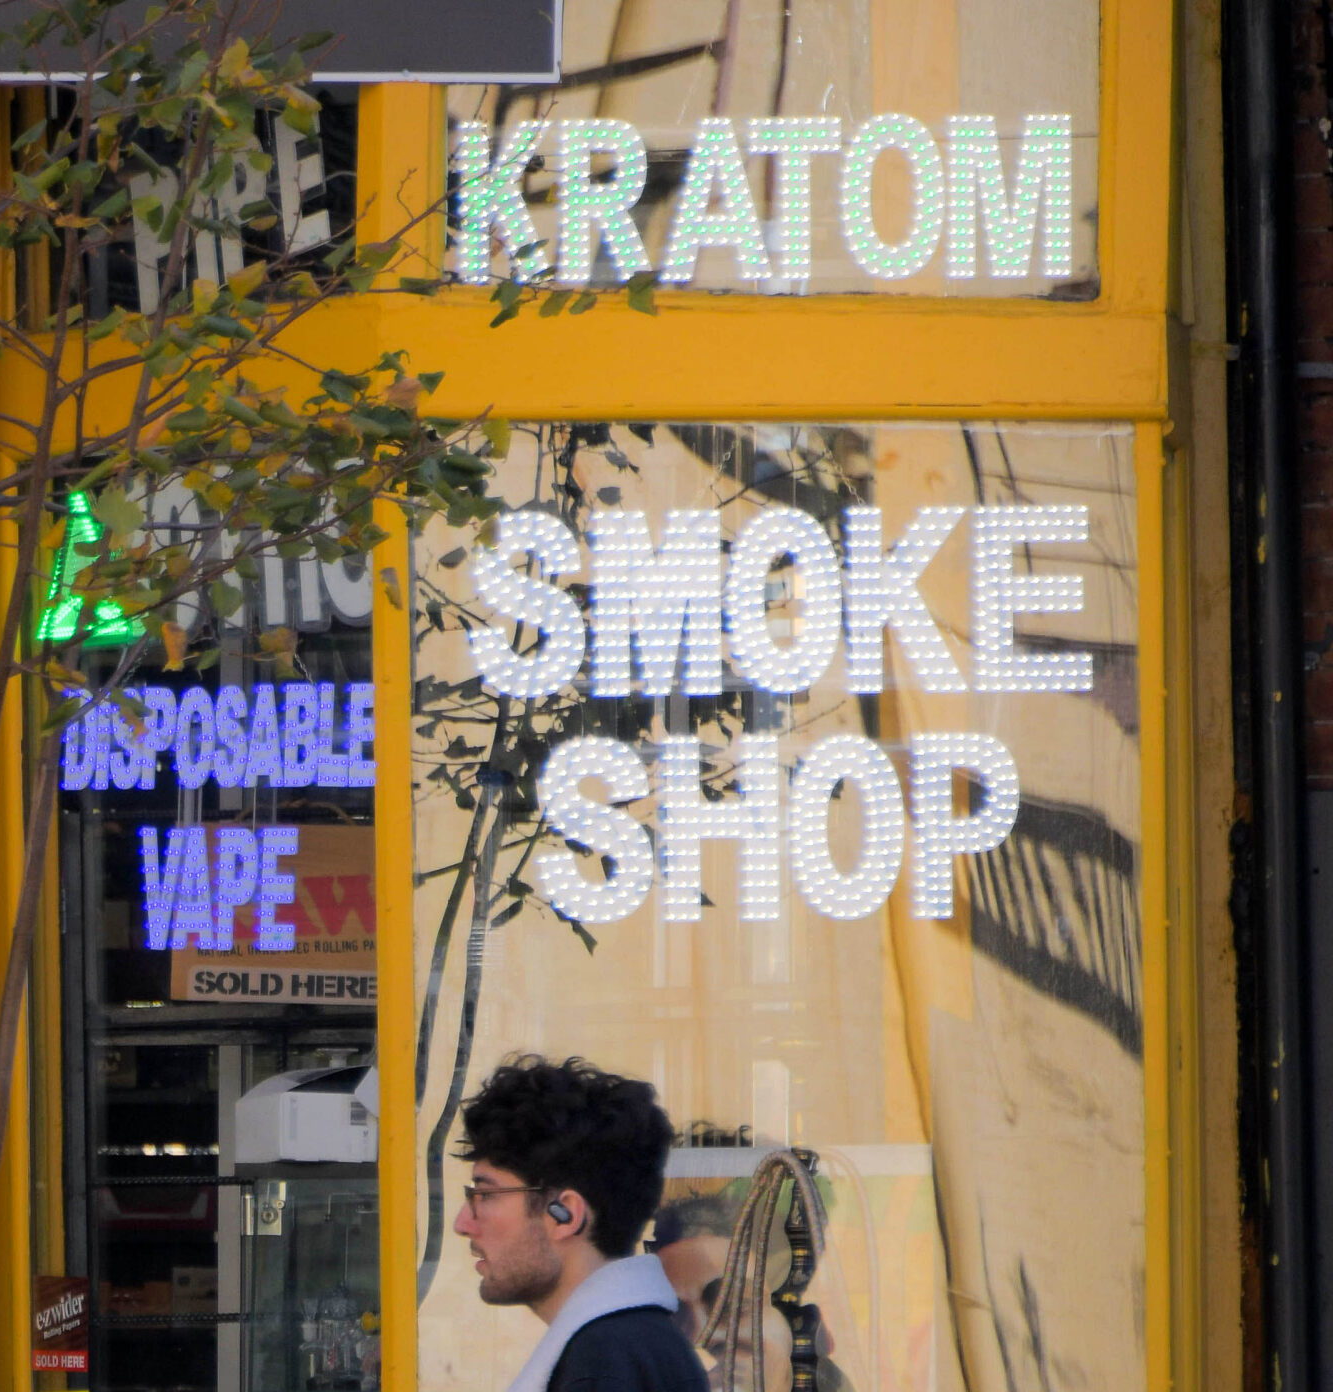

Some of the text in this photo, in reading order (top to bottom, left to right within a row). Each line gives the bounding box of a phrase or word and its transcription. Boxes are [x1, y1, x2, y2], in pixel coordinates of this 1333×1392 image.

[455, 113, 1073, 284] KRATOM
[469, 504, 1094, 699] SMOKE
[63, 683, 377, 790] DISPOSABLE
[535, 731, 1021, 922] SHOP
[139, 828, 299, 950] VAPE
[194, 971, 377, 999] SOLD HERE
[35, 1354, 85, 1369] SOLD HERE
